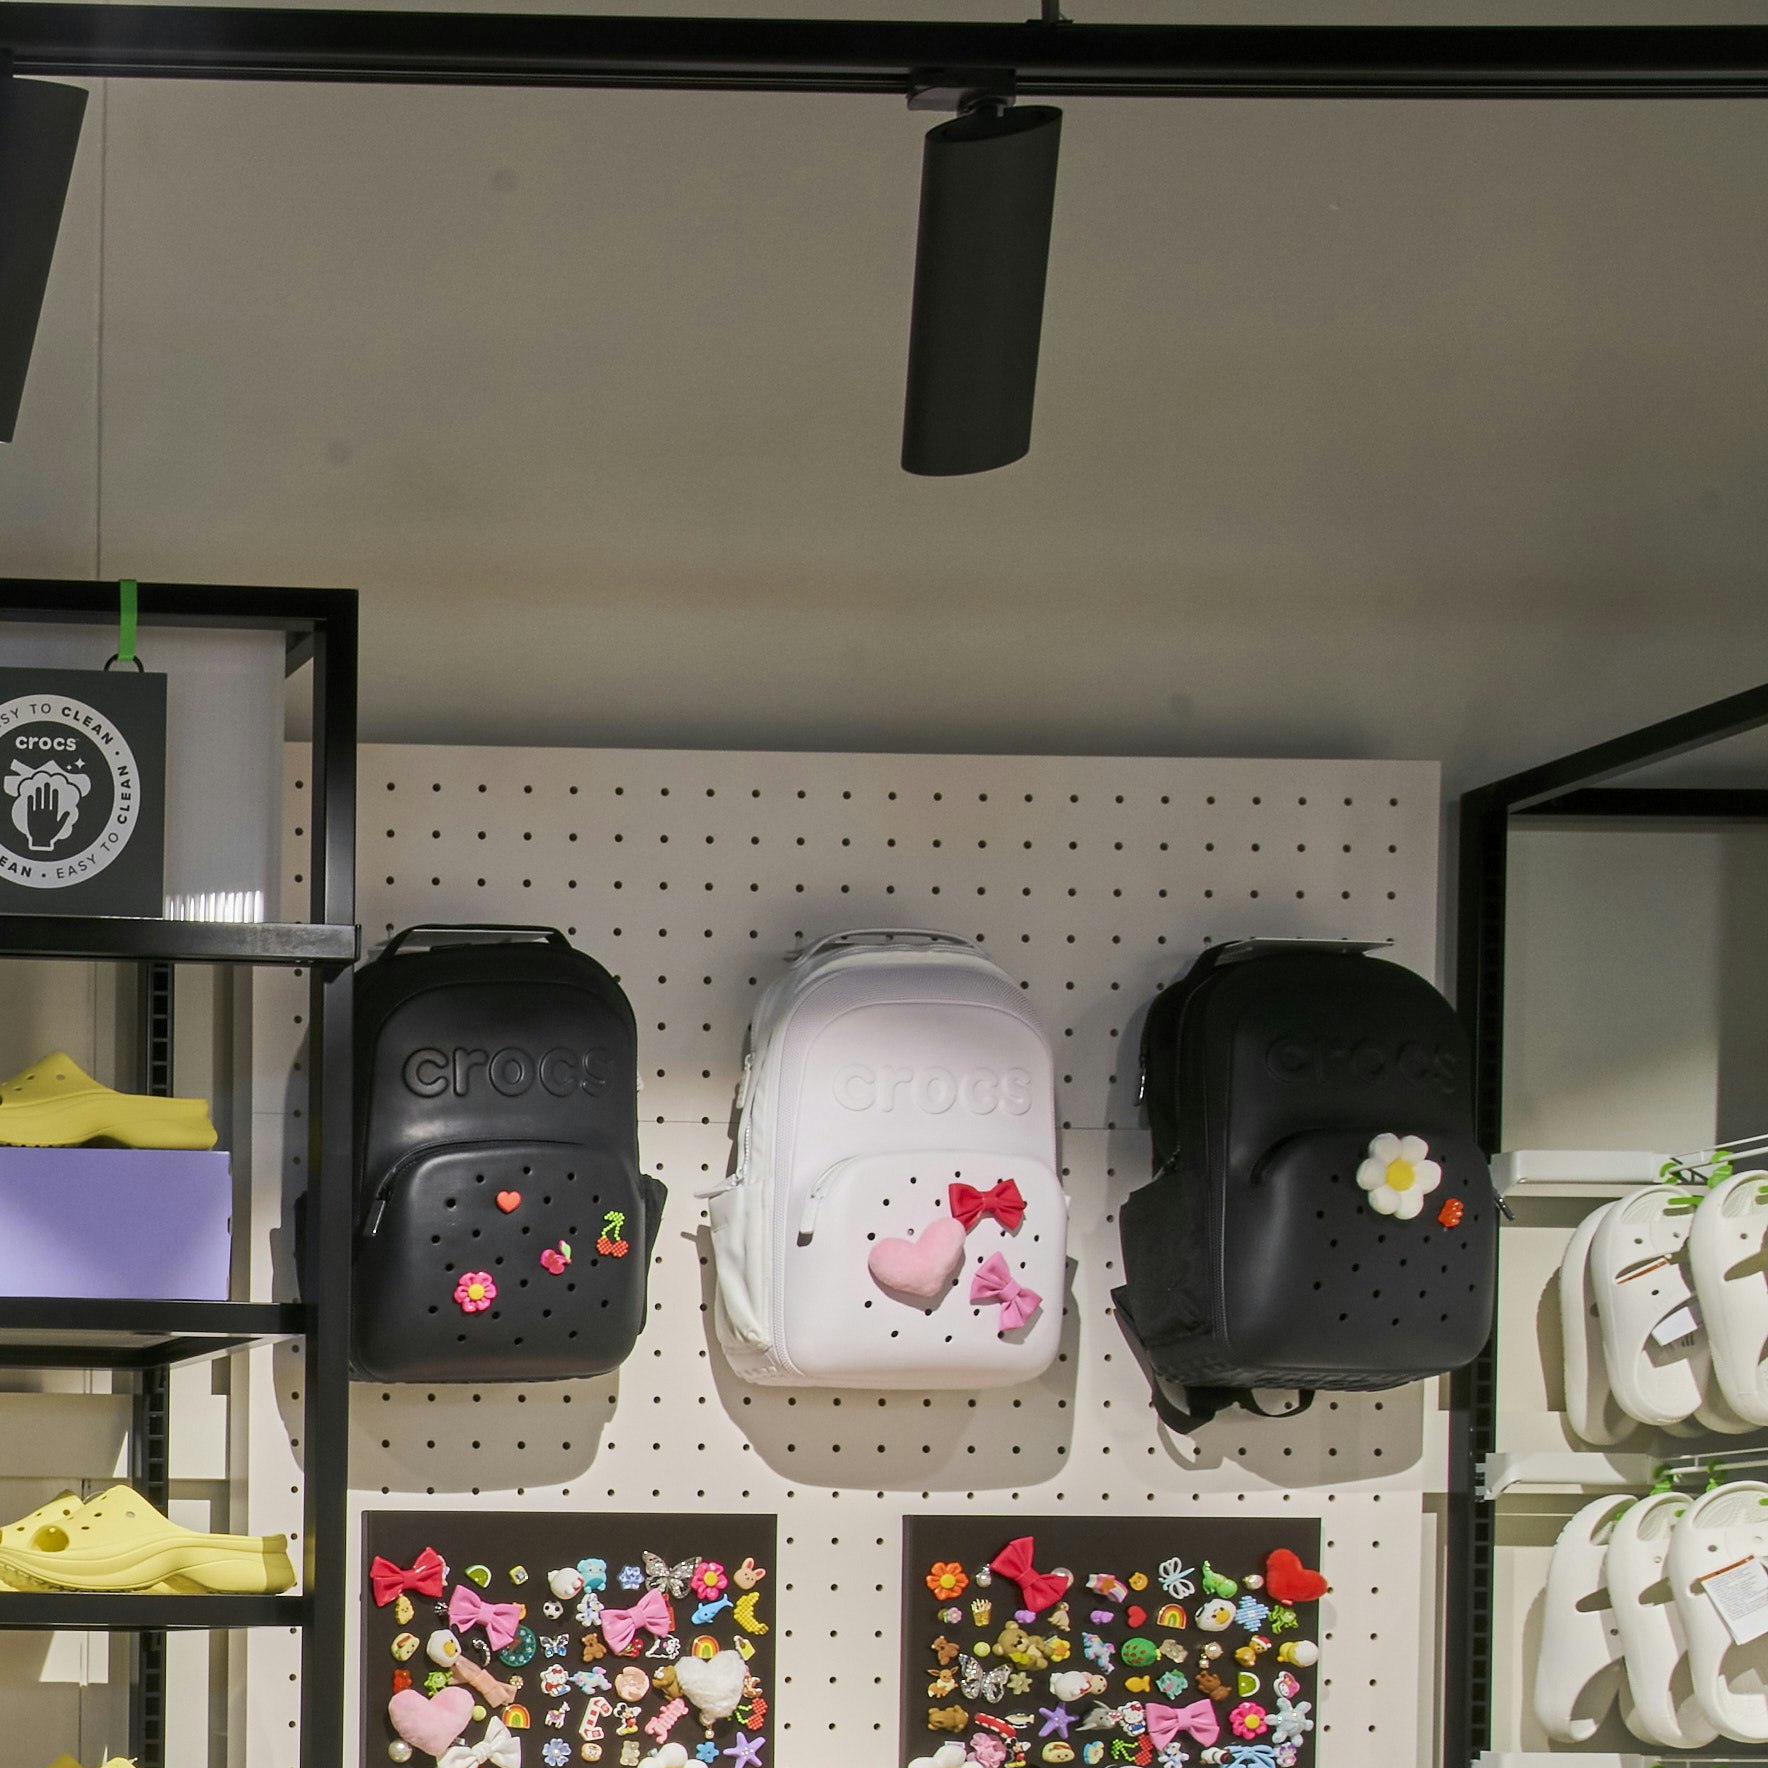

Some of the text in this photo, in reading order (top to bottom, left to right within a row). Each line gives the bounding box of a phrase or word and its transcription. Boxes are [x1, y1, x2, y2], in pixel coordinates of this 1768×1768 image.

[15, 735, 77, 751] crocs
[29, 703, 52, 715] TO
[61, 706, 114, 745] CLEAN
[56, 765, 132, 879] EASY TO CLEAN
[402, 1046, 616, 1099] crocs
[832, 1062, 1034, 1116] crocs
[1265, 1032, 1458, 1093] crocs
